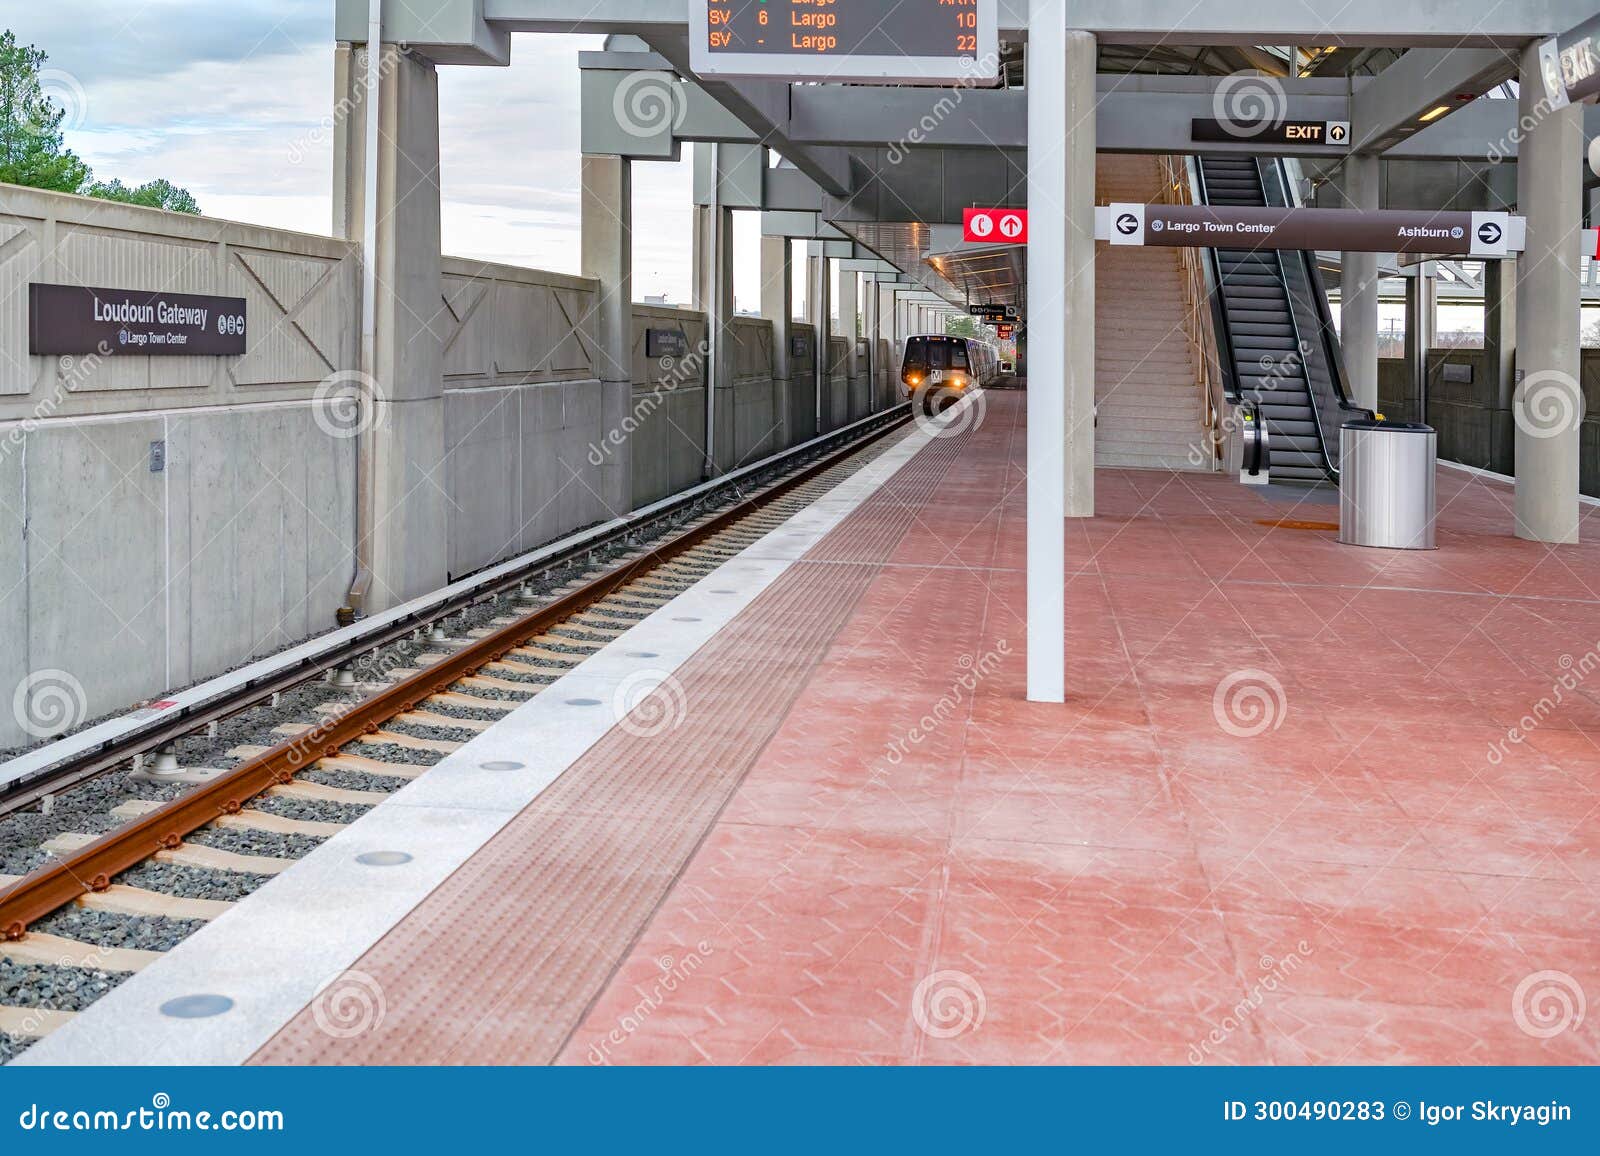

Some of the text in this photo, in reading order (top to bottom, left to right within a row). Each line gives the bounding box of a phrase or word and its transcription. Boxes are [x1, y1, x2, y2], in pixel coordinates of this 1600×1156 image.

[709, 9, 976, 29] SV 6 Largo 10
[709, 31, 731, 47] SV
[791, 32, 836, 51] Largo
[956, 35, 976, 51] 22
[1285, 125, 1322, 139] EXIT
[1167, 220, 1200, 232] Largo
[1202, 221, 1234, 232] Town
[1236, 221, 1276, 233] Center
[1397, 226, 1449, 237] Ashburn
[94, 297, 208, 331] Loudoun Gateway
[127, 332, 148, 346] Largo
[149, 332, 166, 344] Town
[167, 332, 188, 345] Center
